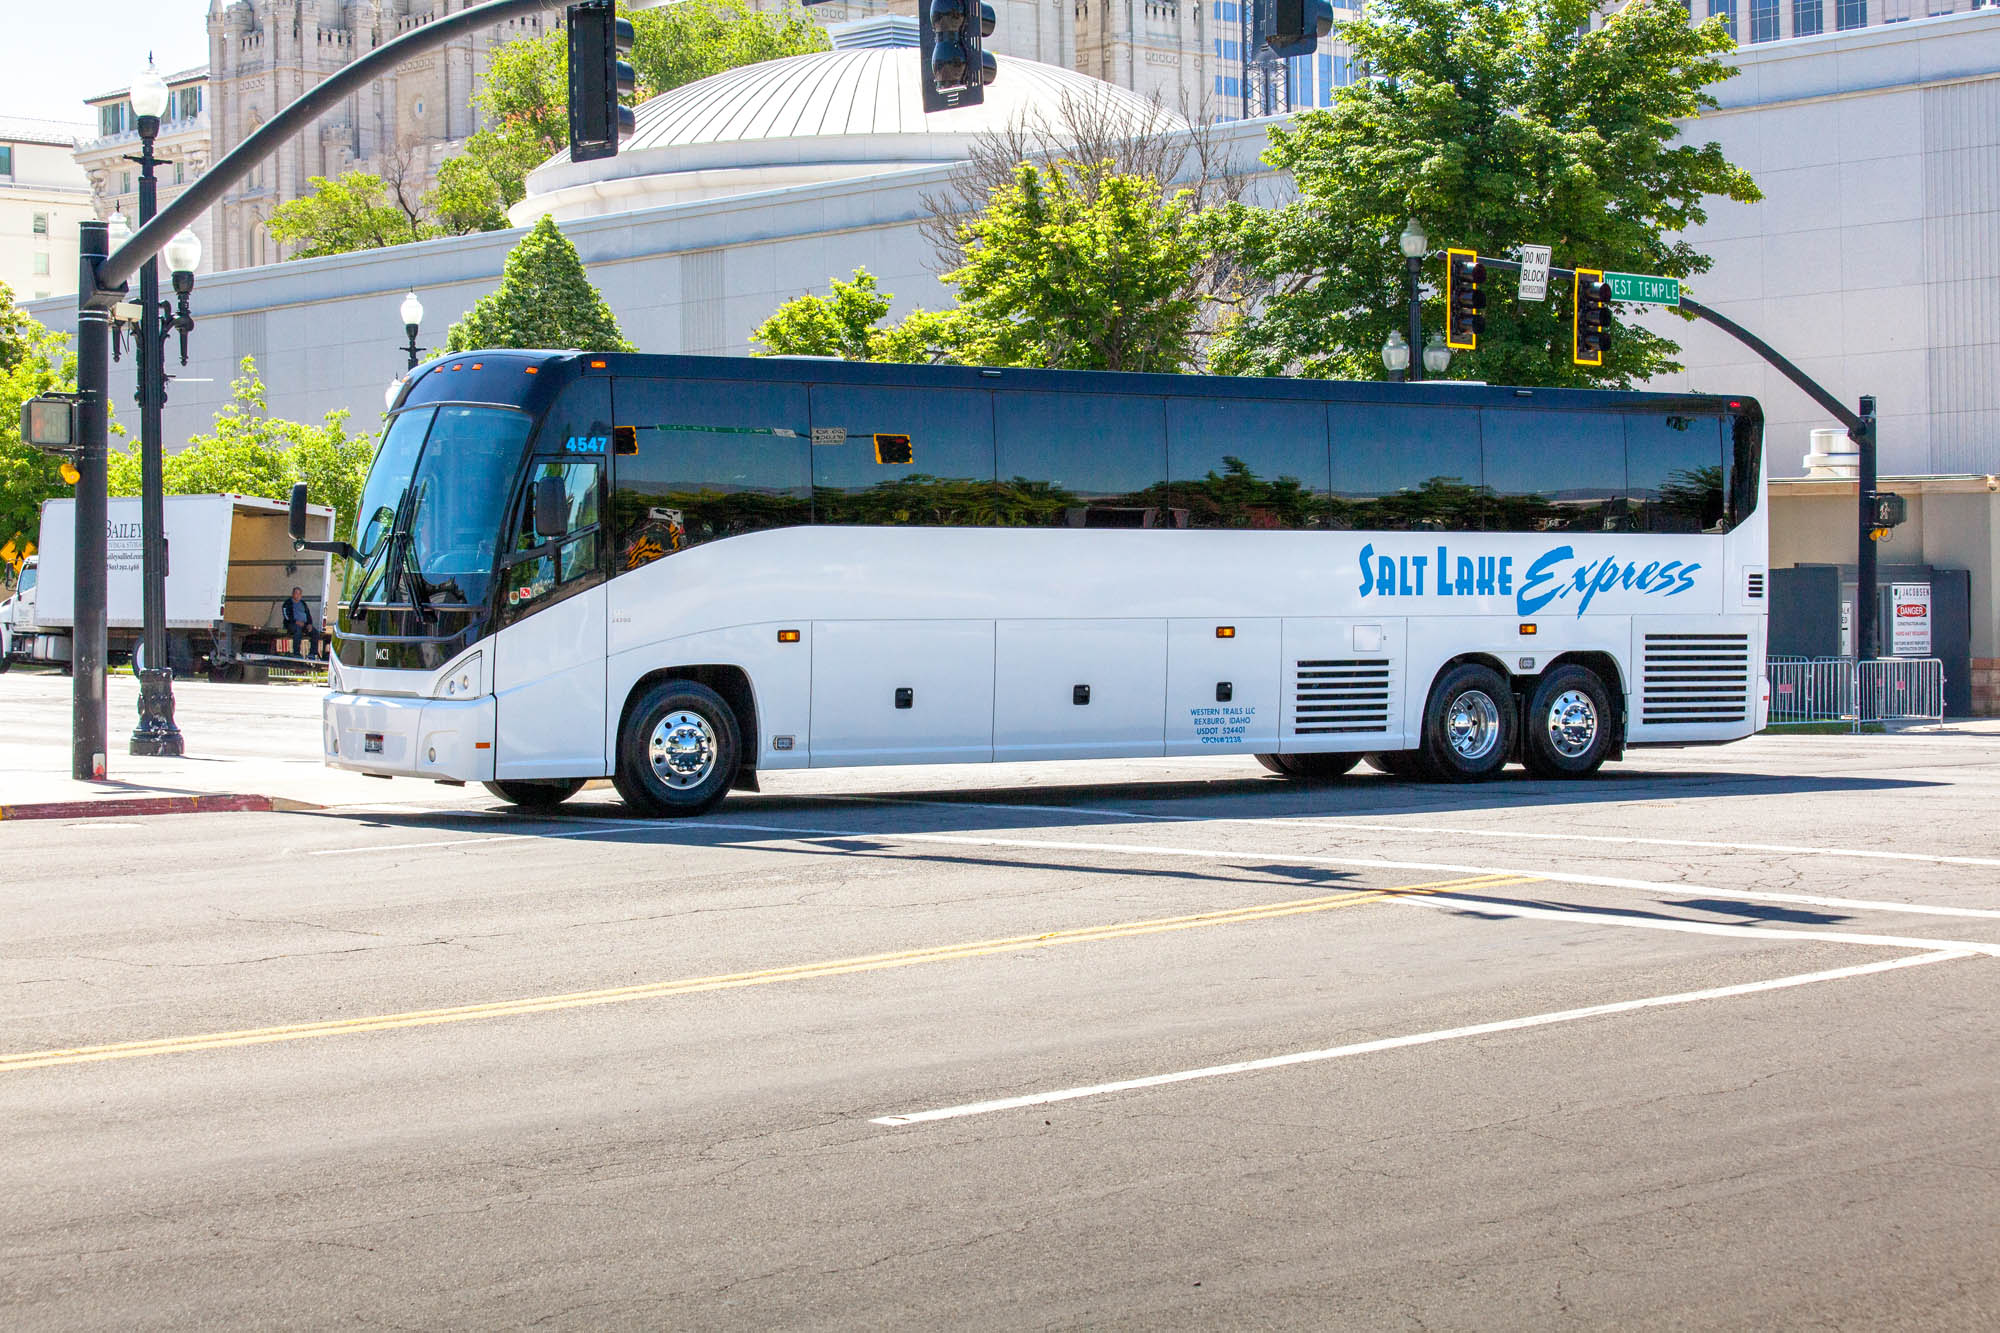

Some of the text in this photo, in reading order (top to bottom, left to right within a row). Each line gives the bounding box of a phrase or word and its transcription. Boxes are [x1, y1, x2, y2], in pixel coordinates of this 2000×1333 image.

[1525, 251, 1548, 265] DO NOT
[1523, 269, 1546, 282] BLOCK
[1638, 281, 1678, 300] TEMPLE
[566, 436, 607, 452] 4547
[1359, 543, 1703, 620] SALT LAKE Express
[1902, 587, 1930, 597] JACOBSEN
[1900, 606, 1924, 615] DANGER
[375, 648, 389, 660] MCI
[1191, 707, 1255, 716] WESTERN TRAILS LLC
[1194, 717, 1227, 725] REXBURG,
[1196, 727, 1245, 735] USDOT 524401
